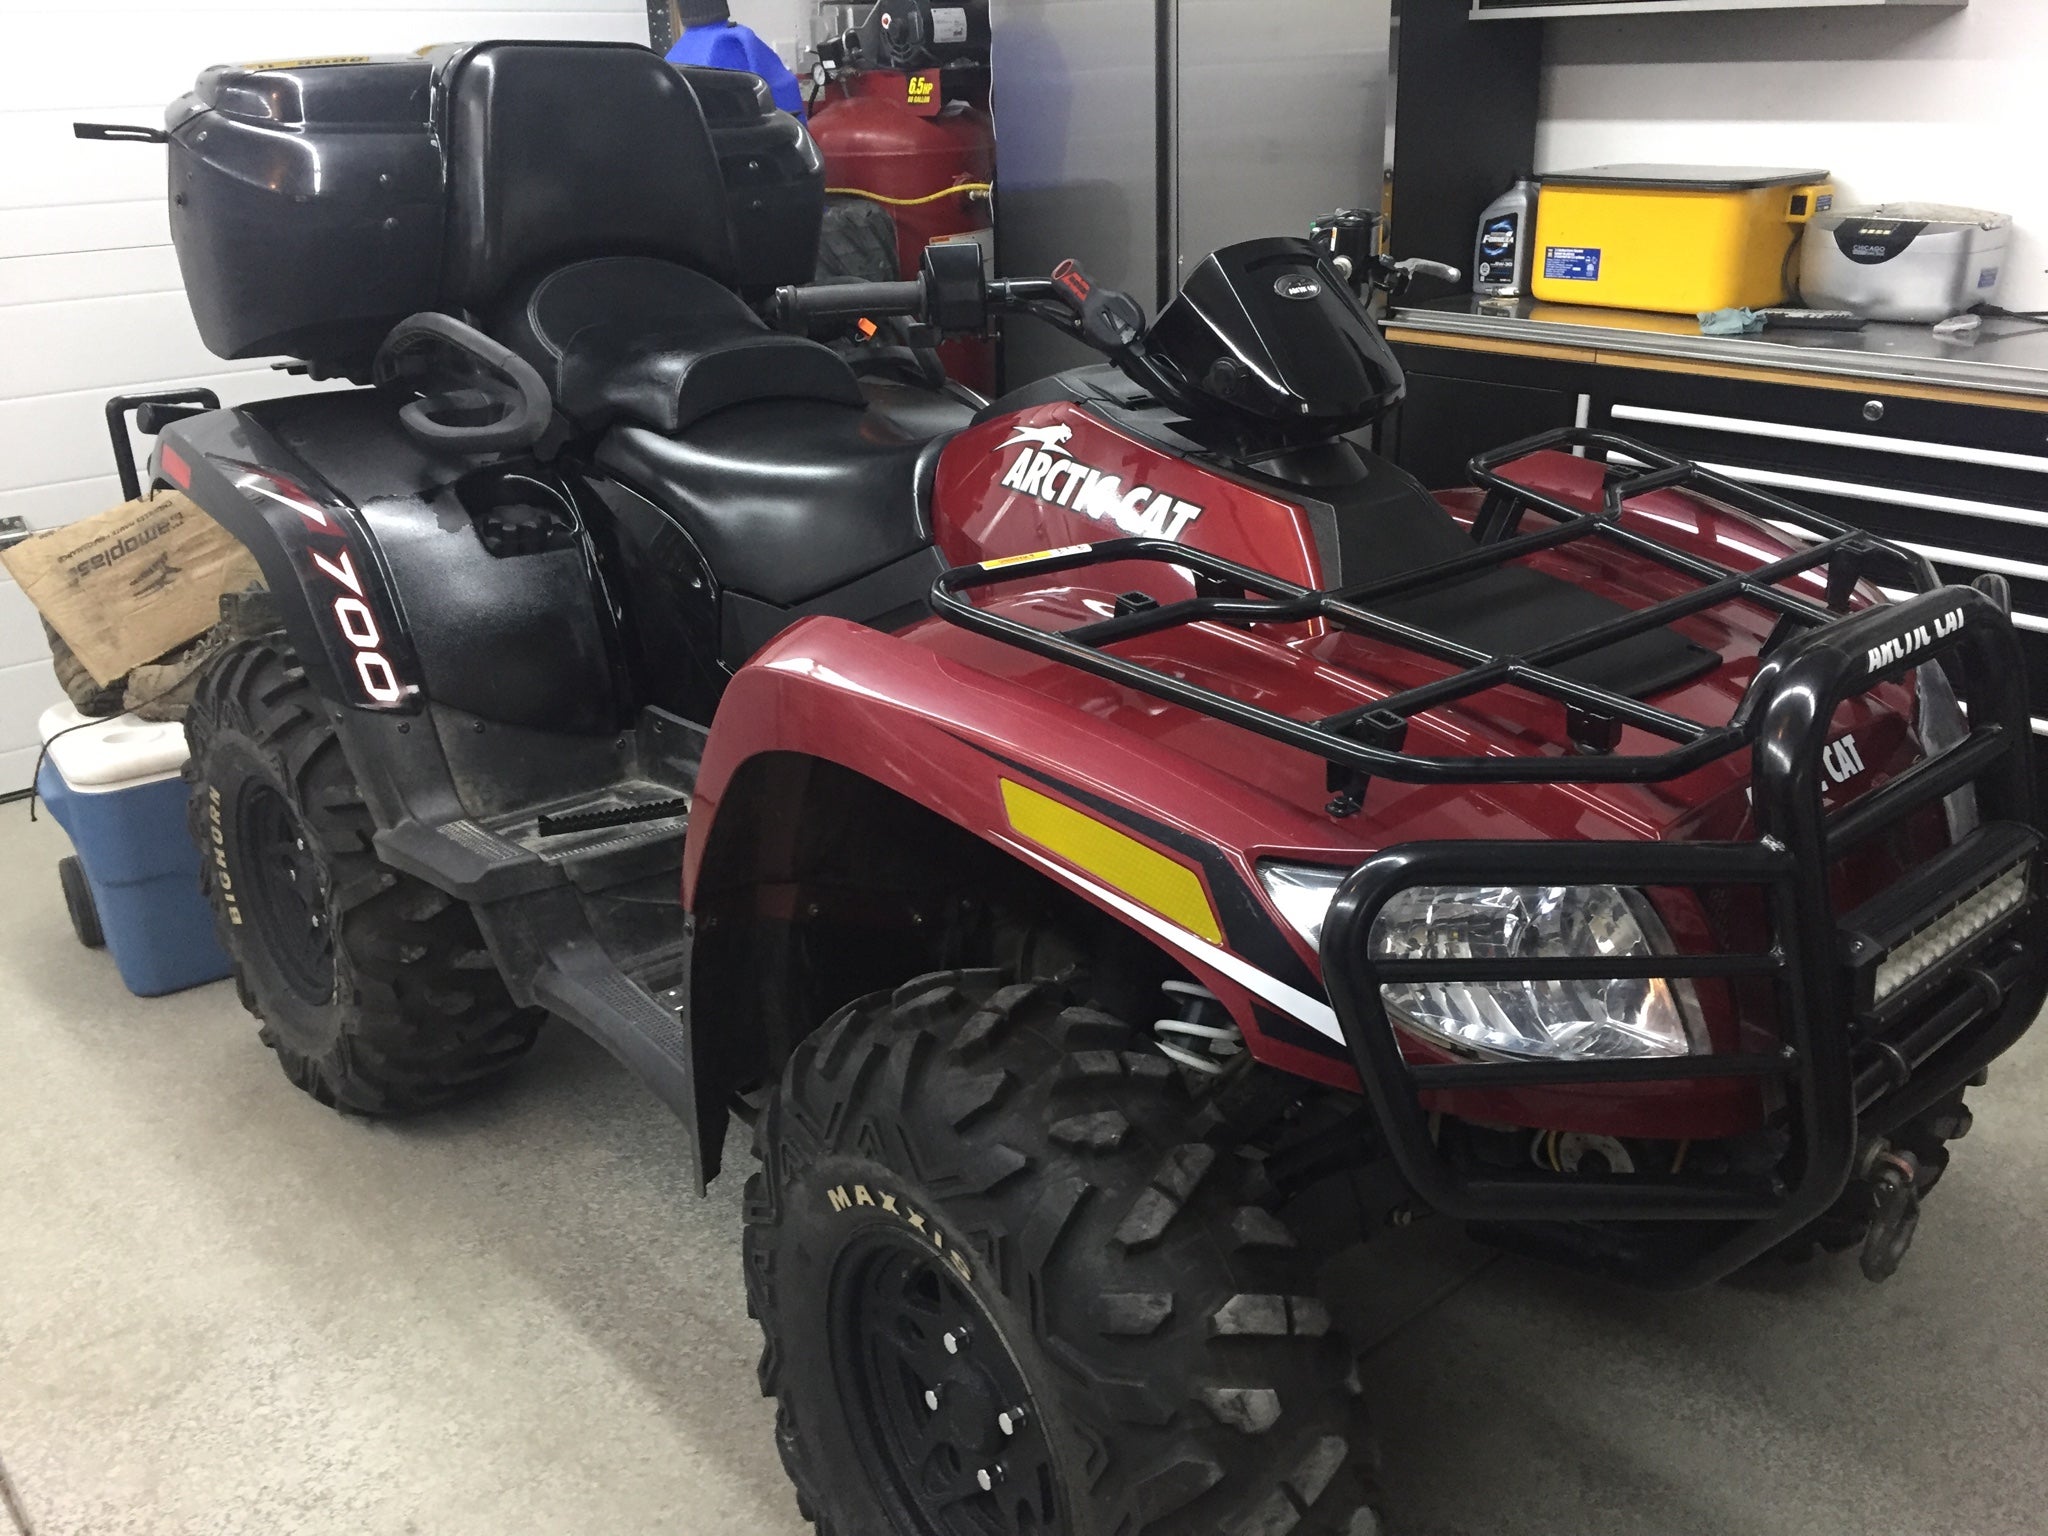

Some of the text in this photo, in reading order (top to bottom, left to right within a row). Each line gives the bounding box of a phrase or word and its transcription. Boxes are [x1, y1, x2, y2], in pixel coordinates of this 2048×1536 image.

[1853, 244, 1886, 252] CHICAGO
[1001, 447, 1203, 542] ARCTIC CAT
[312, 550, 401, 703] 700
[1822, 733, 1866, 783] CAT
[209, 784, 243, 925] BIGHORN
[826, 1184, 972, 1281] MAXXIS
